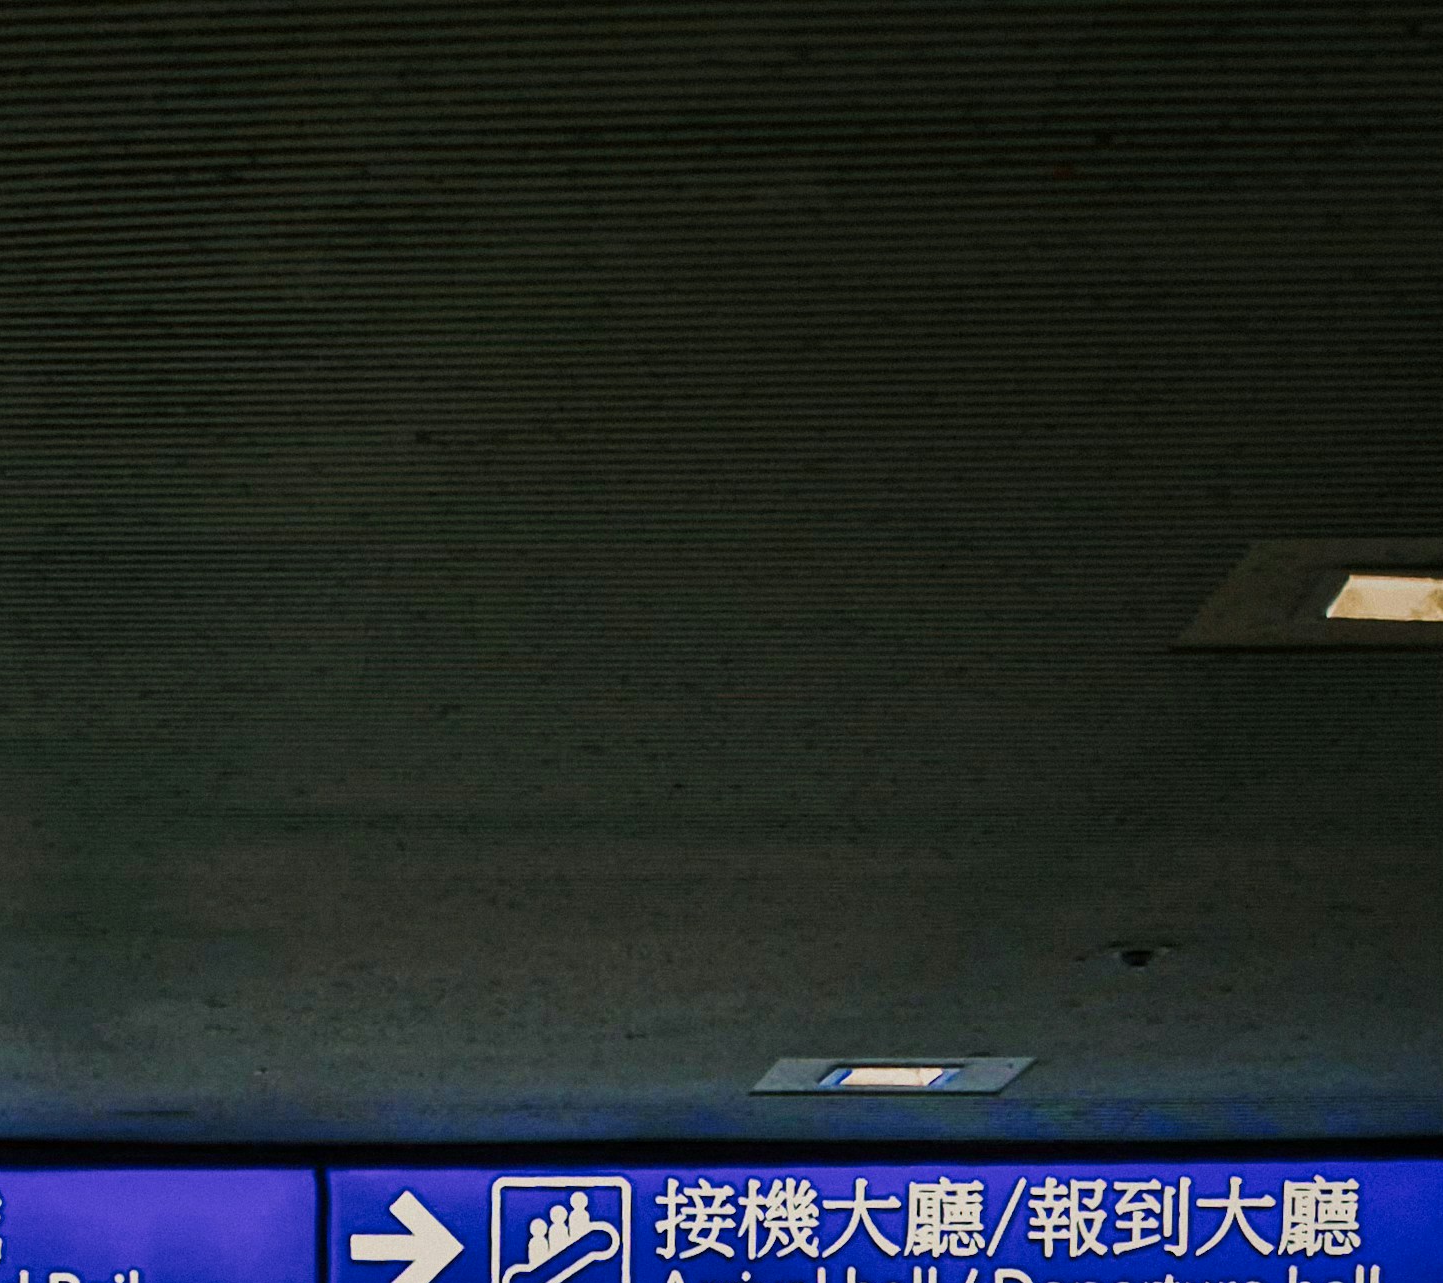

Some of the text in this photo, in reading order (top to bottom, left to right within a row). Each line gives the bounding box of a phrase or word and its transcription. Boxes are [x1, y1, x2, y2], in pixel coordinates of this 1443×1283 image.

[654, 1176, 1362, 1260] 接機大廳/報到大廳
